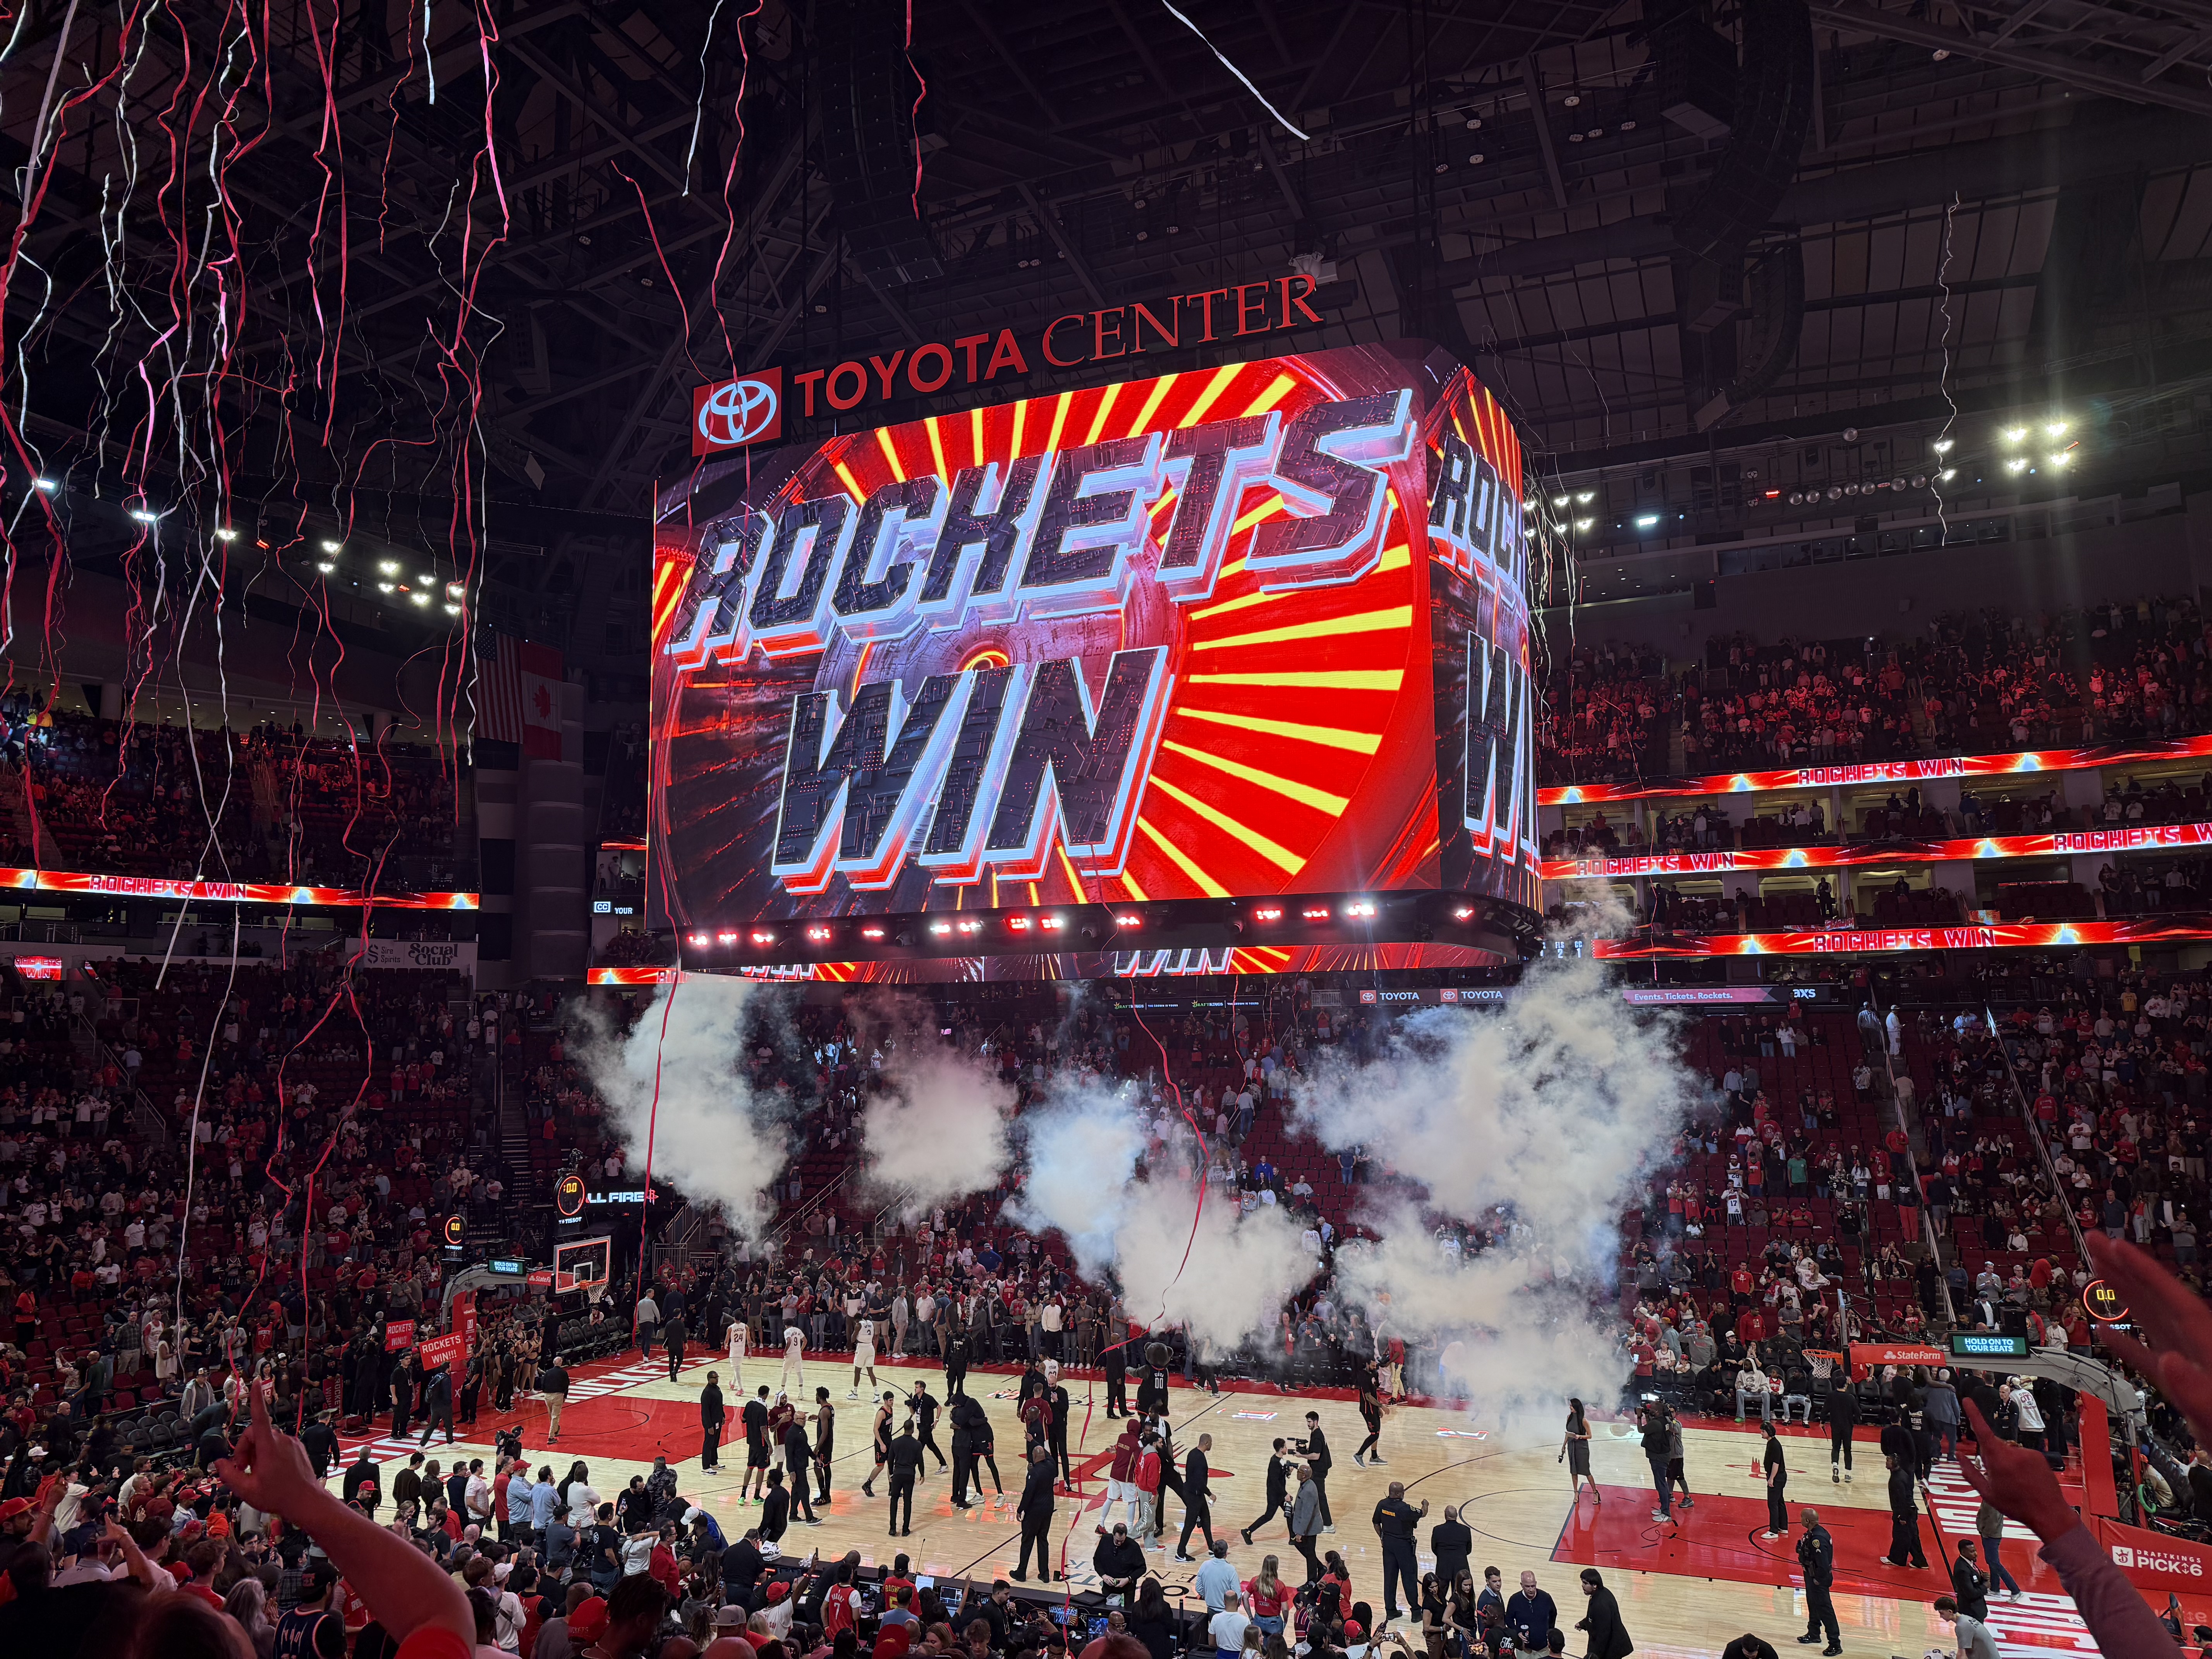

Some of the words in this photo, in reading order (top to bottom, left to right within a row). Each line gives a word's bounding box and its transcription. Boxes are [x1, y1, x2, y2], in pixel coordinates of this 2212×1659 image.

[794, 328, 1030, 417] TOYOTA
[1042, 273, 1324, 367] CENTER
[665, 388, 1417, 673] ROCKETS
[771, 644, 1173, 895] WIN
[1798, 762, 1906, 785] ROCKETS
[1918, 758, 1964, 778] WIN
[2054, 825, 2181, 851] ROCKETS
[1577, 855, 1679, 876] ROCKETS
[1690, 853, 1735, 871] WIN
[89, 874, 194, 896] ROCKETS
[205, 882, 247, 899] WIN
[1814, 931, 1931, 952] ROCKETS
[1944, 929, 1994, 948] WIN
[408, 943, 458, 958] Social
[1558, 948, 1563, 958] 2
[1577, 948, 1581, 958] 1
[381, 955, 400, 963] Spirits
[415, 953, 451, 965] Club
[26, 968, 50, 978] WIN
[1379, 992, 1419, 1000] TOYOTA
[1461, 991, 1503, 999] TOYOTA
[609, 1192, 644, 1203] FIRE
[2096, 1290, 2115, 1300] 0.0
[388, 1323, 411, 1334] ROCKETS
[392, 1336, 406, 1346] WIN!!!
[422, 1335, 461, 1353] ROCKETS
[734, 1333, 743, 1343] 24
[793, 1336, 798, 1346] 9
[431, 1350, 457, 1364] WIN!!!
[1155, 1377, 1163, 1389] 00
[264, 1389, 271, 1397] 13
[2137, 1549, 2201, 1563] DRAFTKINGS
[834, 1602, 840, 1620] 7
[1500, 1637, 1514, 1649] The
